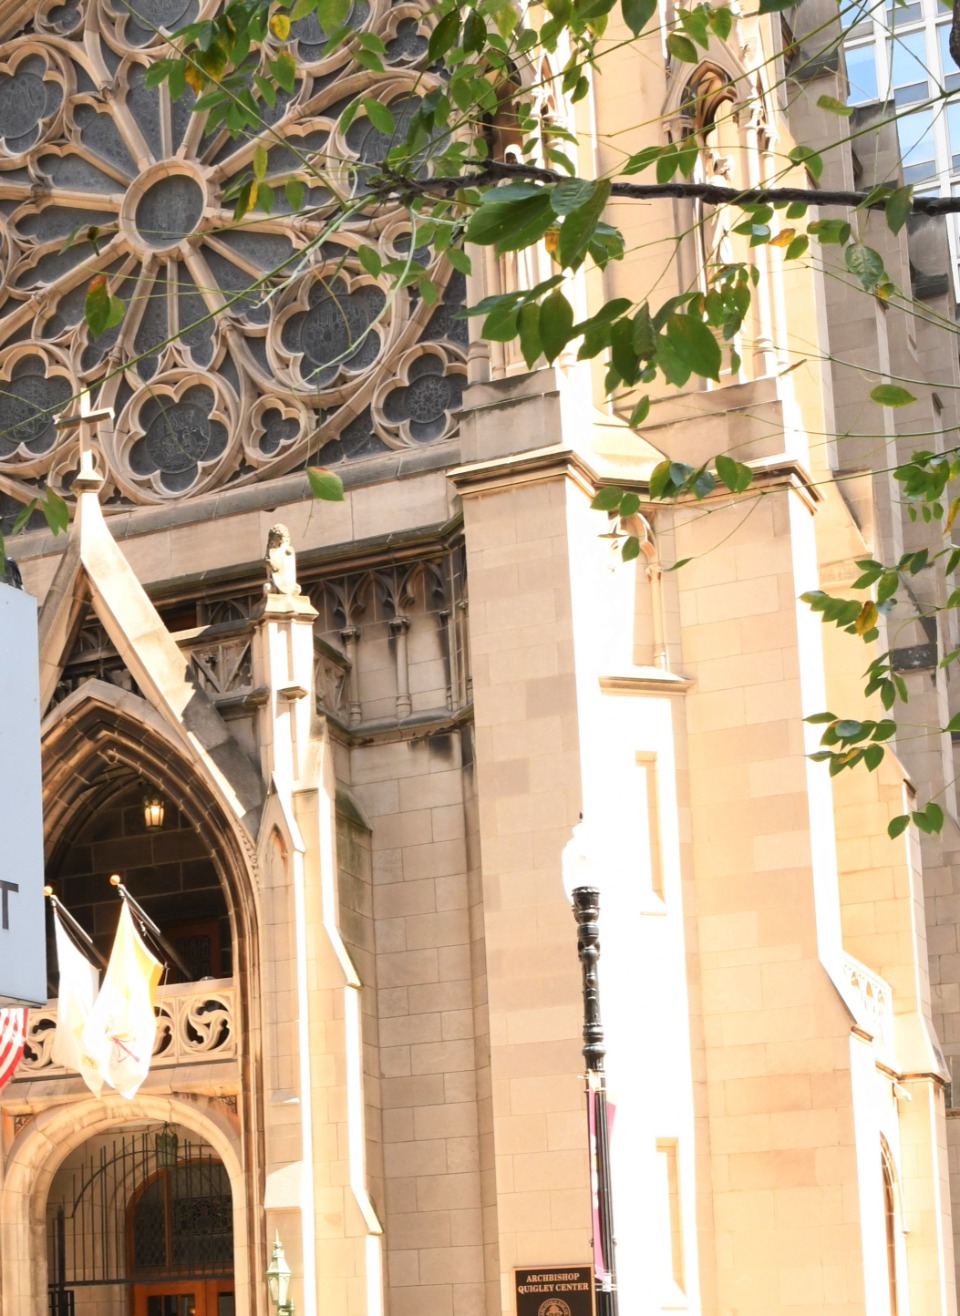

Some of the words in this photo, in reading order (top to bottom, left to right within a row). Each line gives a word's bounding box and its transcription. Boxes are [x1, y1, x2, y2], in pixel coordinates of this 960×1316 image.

[526, 1272, 580, 1283] ARCHBISHOP
[518, 1284, 555, 1294] QUIGLEY
[555, 1282, 589, 1292] CENTER
